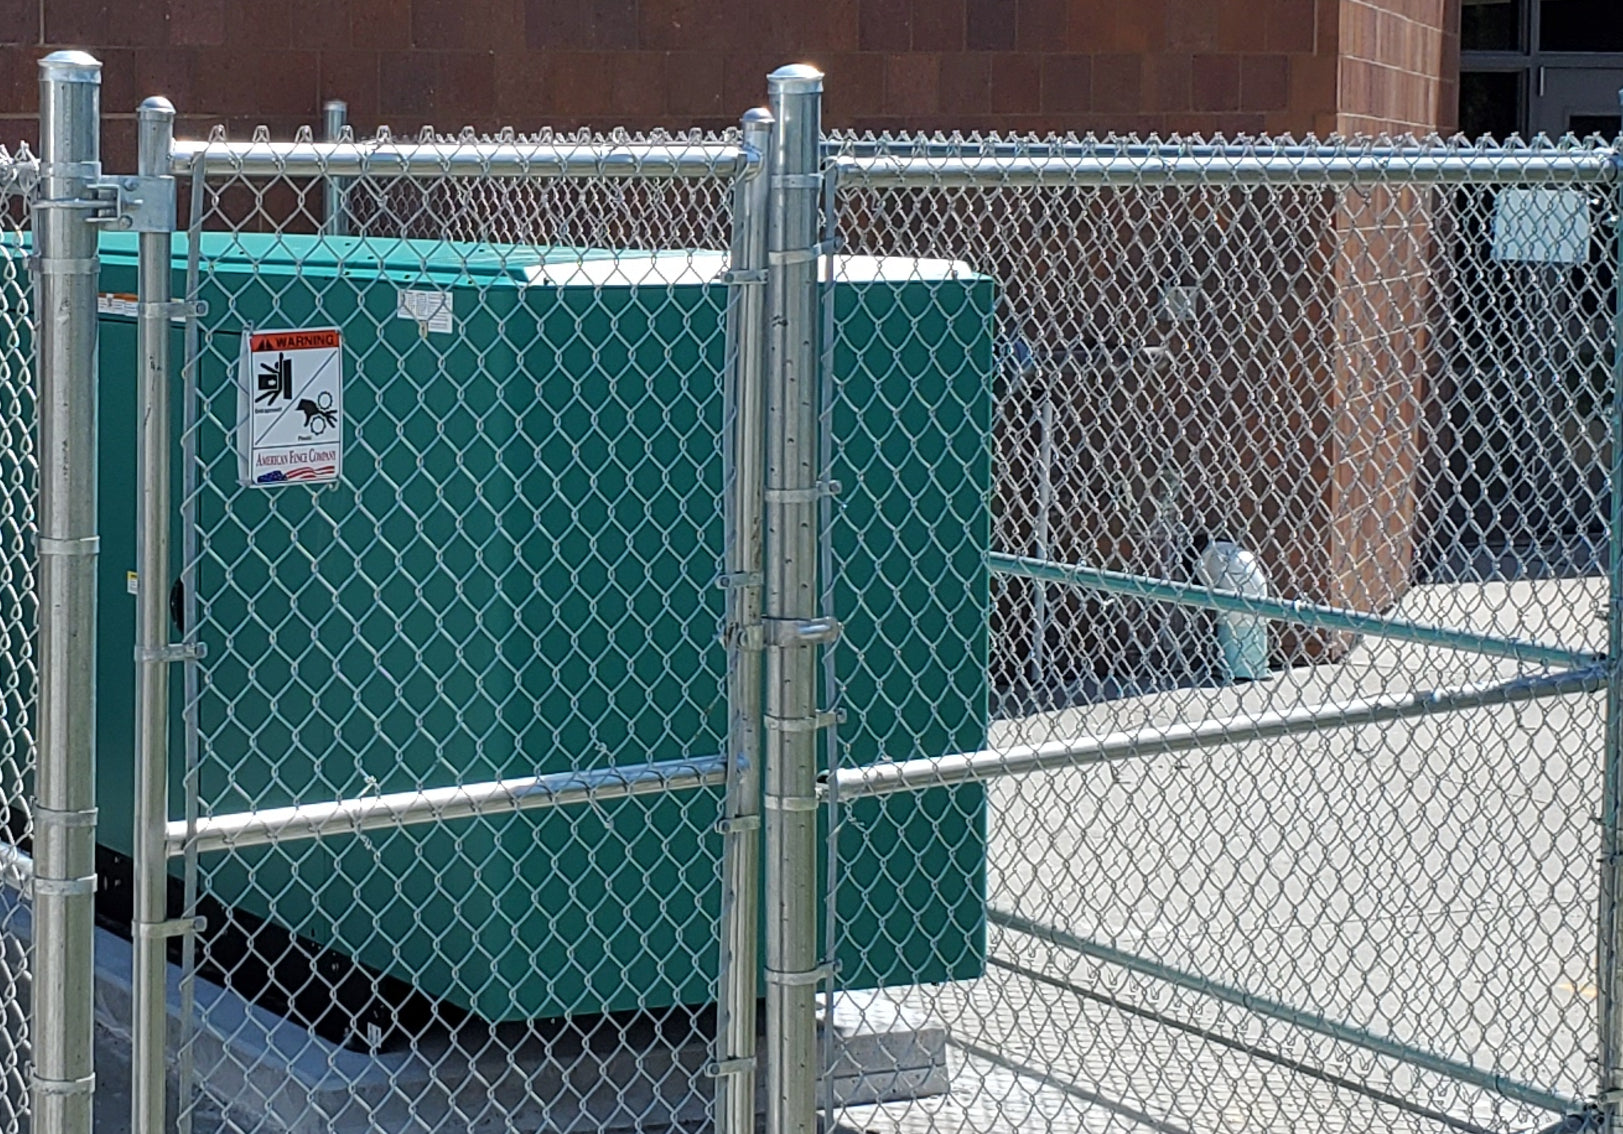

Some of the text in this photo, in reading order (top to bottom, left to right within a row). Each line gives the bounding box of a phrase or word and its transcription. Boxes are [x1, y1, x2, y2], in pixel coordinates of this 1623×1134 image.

[275, 335, 334, 348] WARNING
[256, 448, 336, 466] AMERICAN FENCE COMPANY
